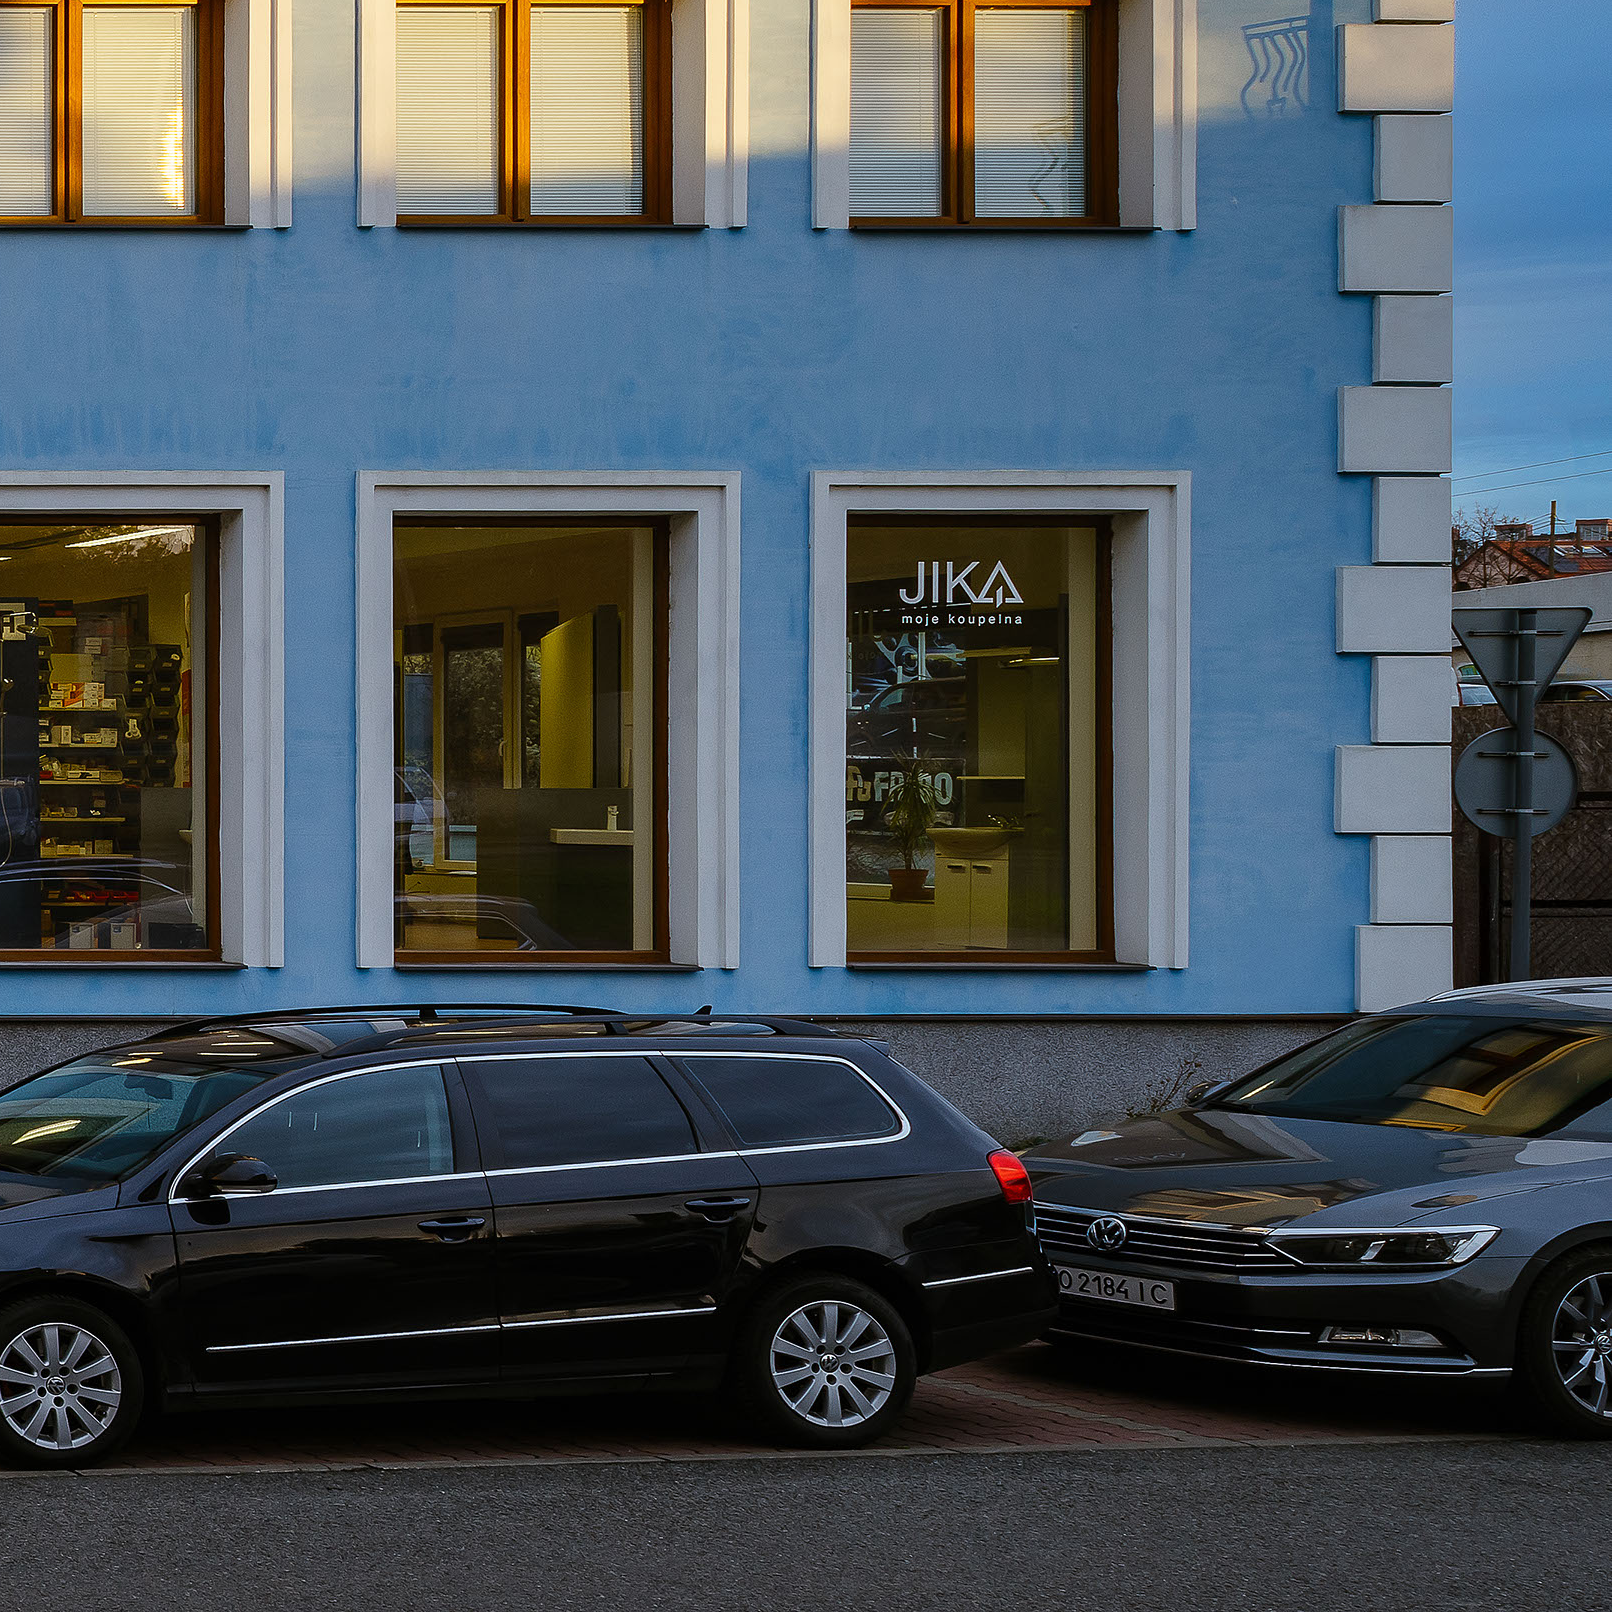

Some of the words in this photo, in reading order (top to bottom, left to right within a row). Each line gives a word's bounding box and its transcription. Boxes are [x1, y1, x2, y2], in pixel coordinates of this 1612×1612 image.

[899, 560, 1024, 606] JIKA
[901, 613, 939, 627] moje
[948, 613, 1023, 627] koupelna
[1077, 1272, 1129, 1299] 2184
